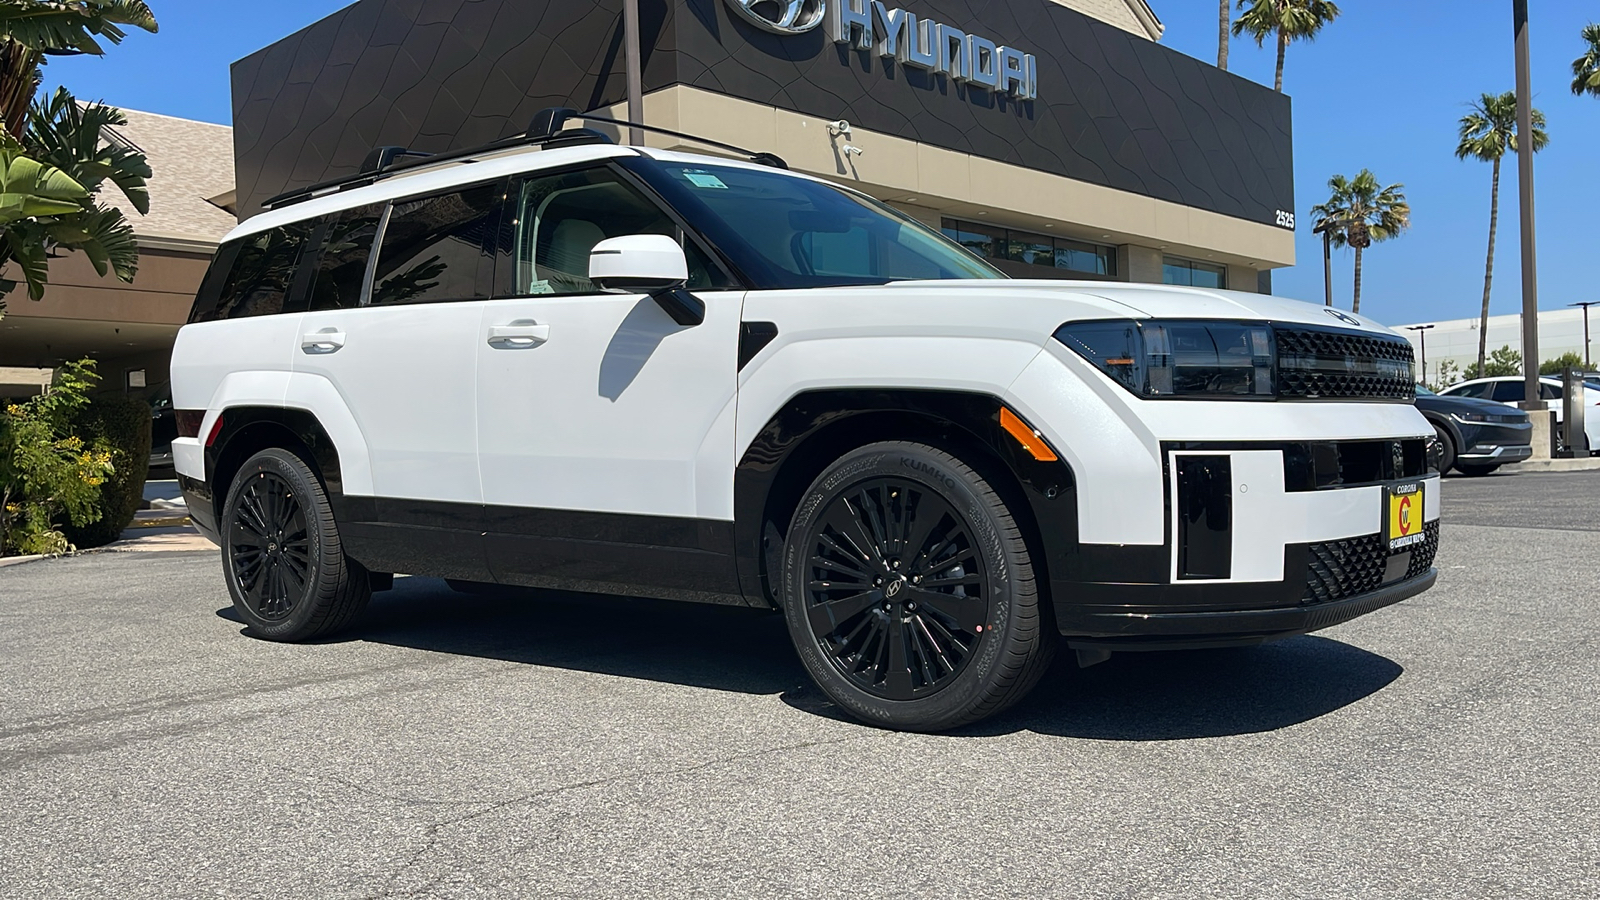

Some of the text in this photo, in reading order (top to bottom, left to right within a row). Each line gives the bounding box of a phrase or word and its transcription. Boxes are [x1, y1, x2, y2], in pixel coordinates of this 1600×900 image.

[833, 0, 1037, 100] HYUNDAI
[1275, 209, 1295, 229] 2525
[900, 457, 956, 489] KUMHO
